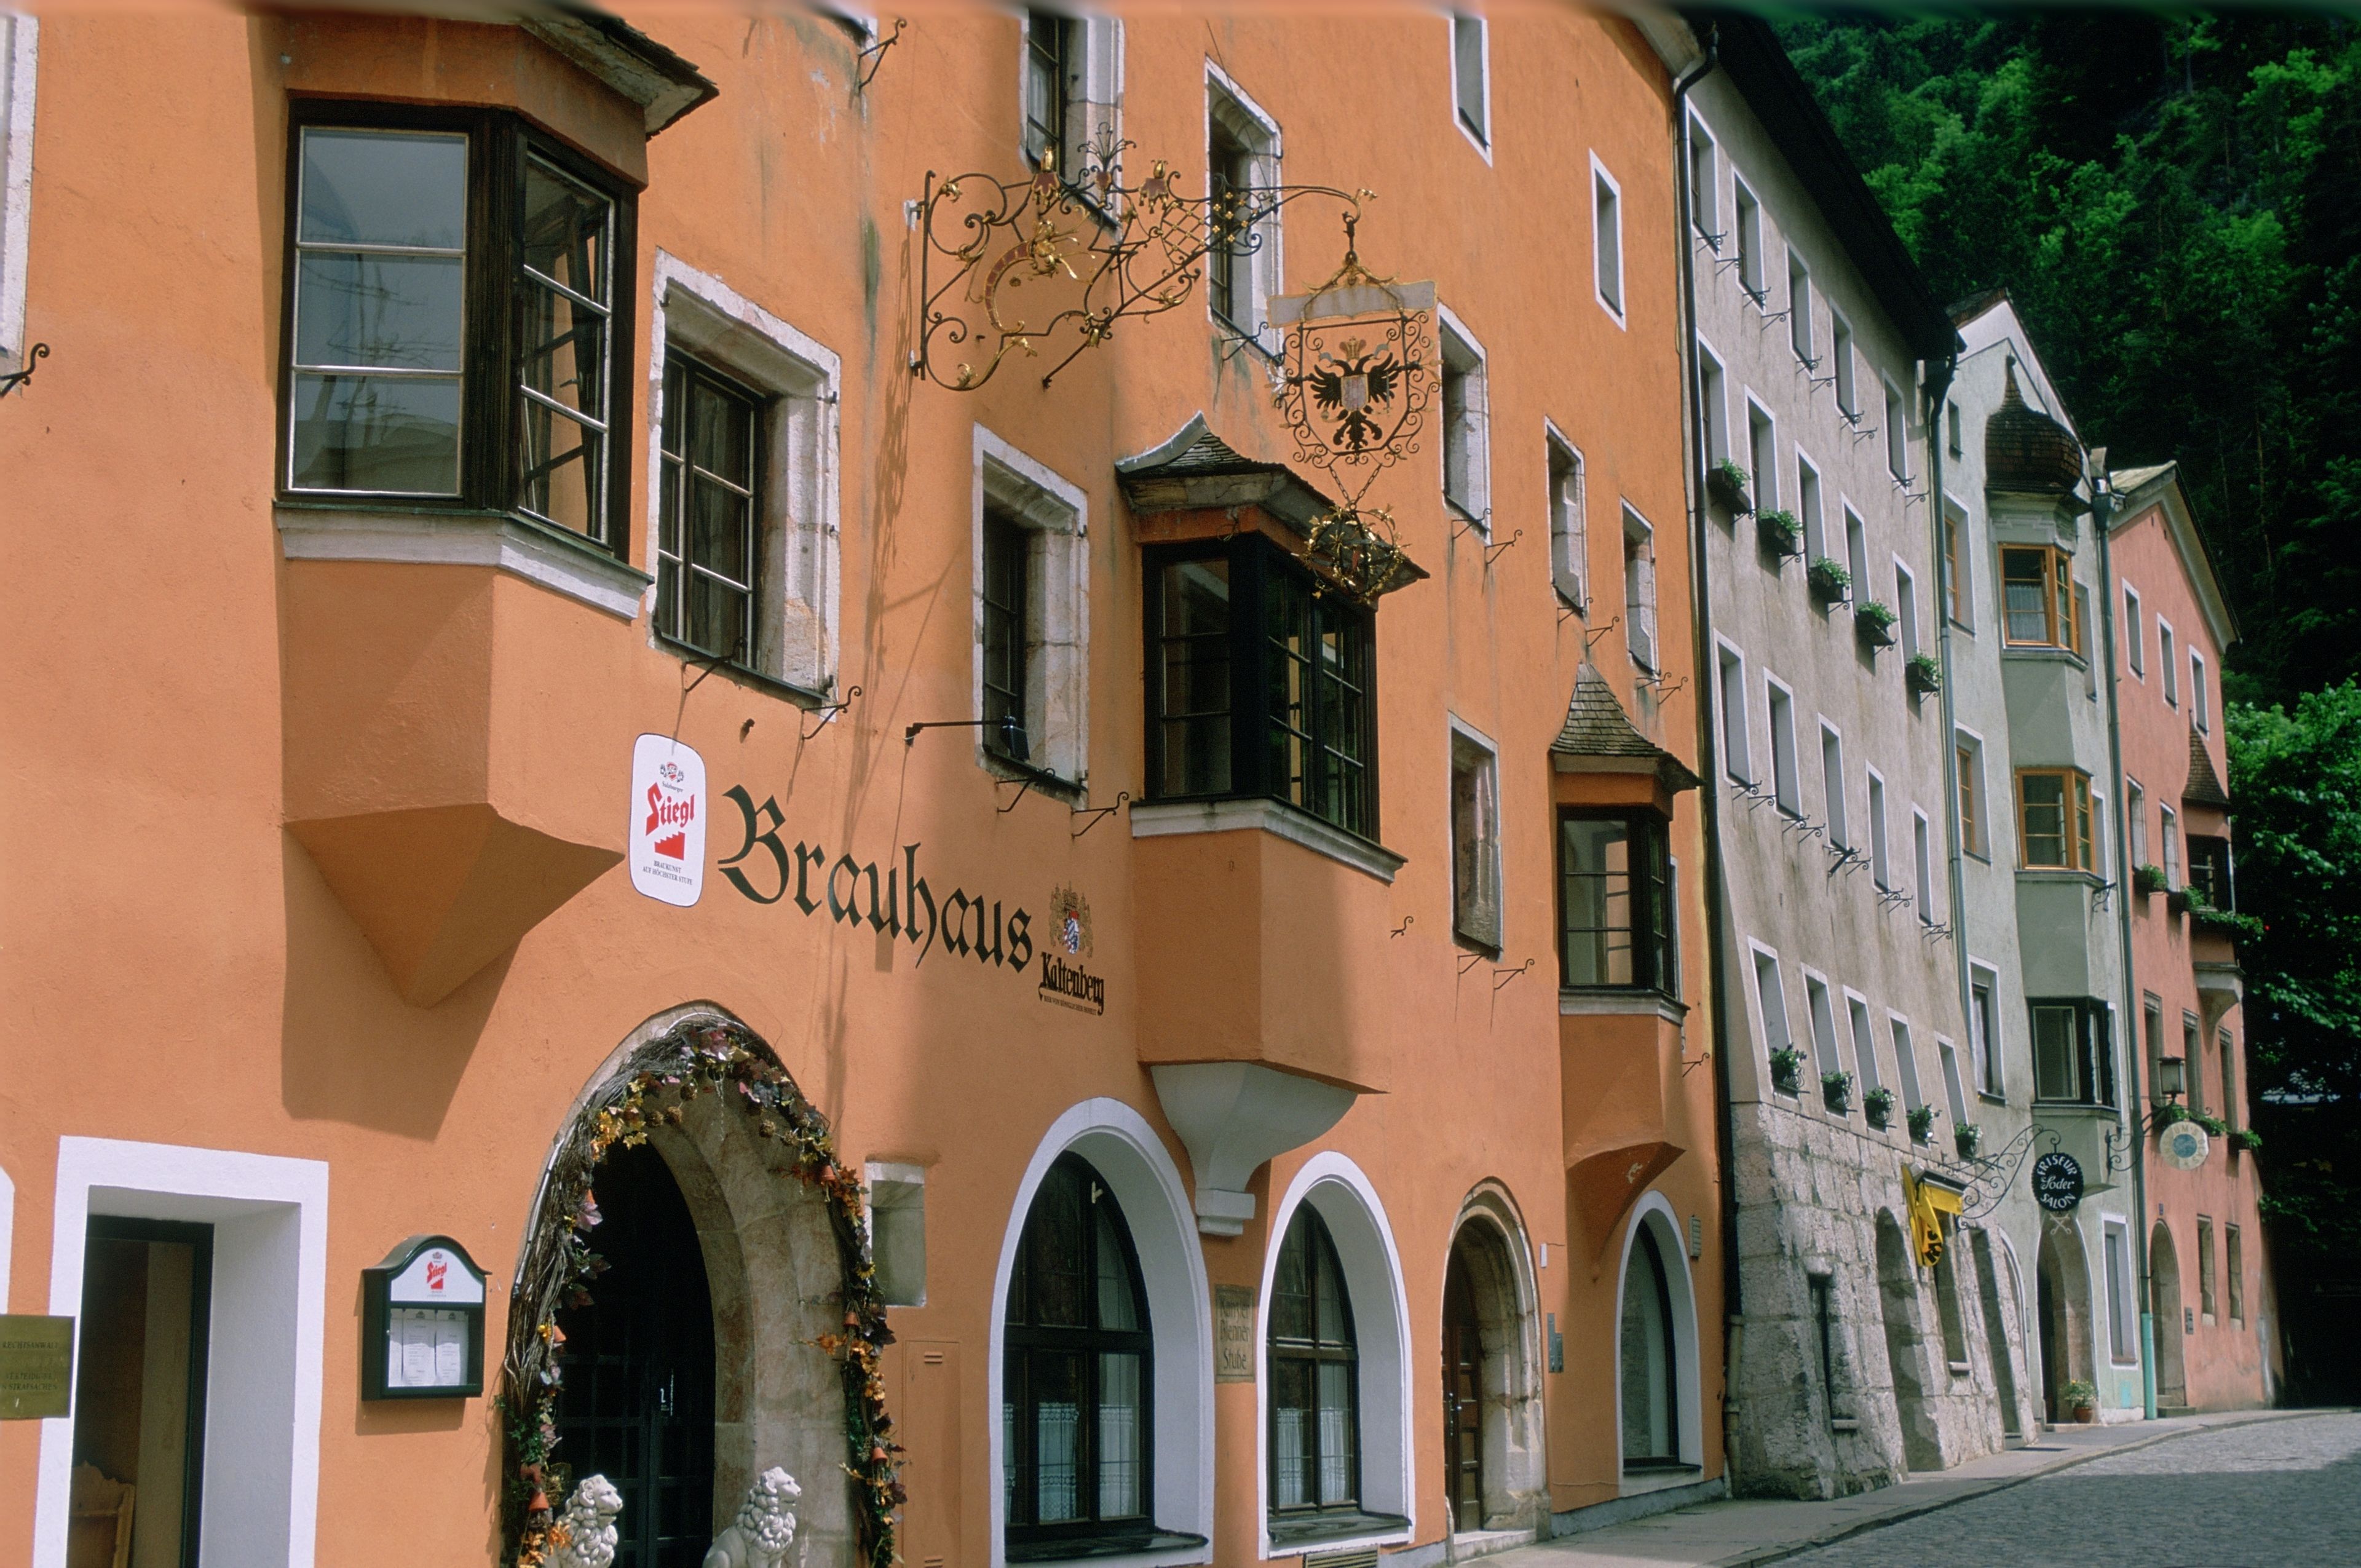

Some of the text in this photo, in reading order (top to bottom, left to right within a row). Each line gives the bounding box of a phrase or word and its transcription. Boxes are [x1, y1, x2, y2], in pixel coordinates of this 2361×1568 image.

[646, 782, 695, 836] Stiegl
[654, 860, 681, 873] BRAUKUNST
[679, 876, 692, 885] STUFE
[718, 784, 1033, 973] Brauhaus
[1038, 952, 1104, 1016] Kaltenberg
[2037, 1155, 2077, 1175] FRISEUR
[2040, 1193, 2076, 1209] SALON
[427, 1261, 447, 1283] Stiegl
[1224, 1347, 1247, 1370] Stube
